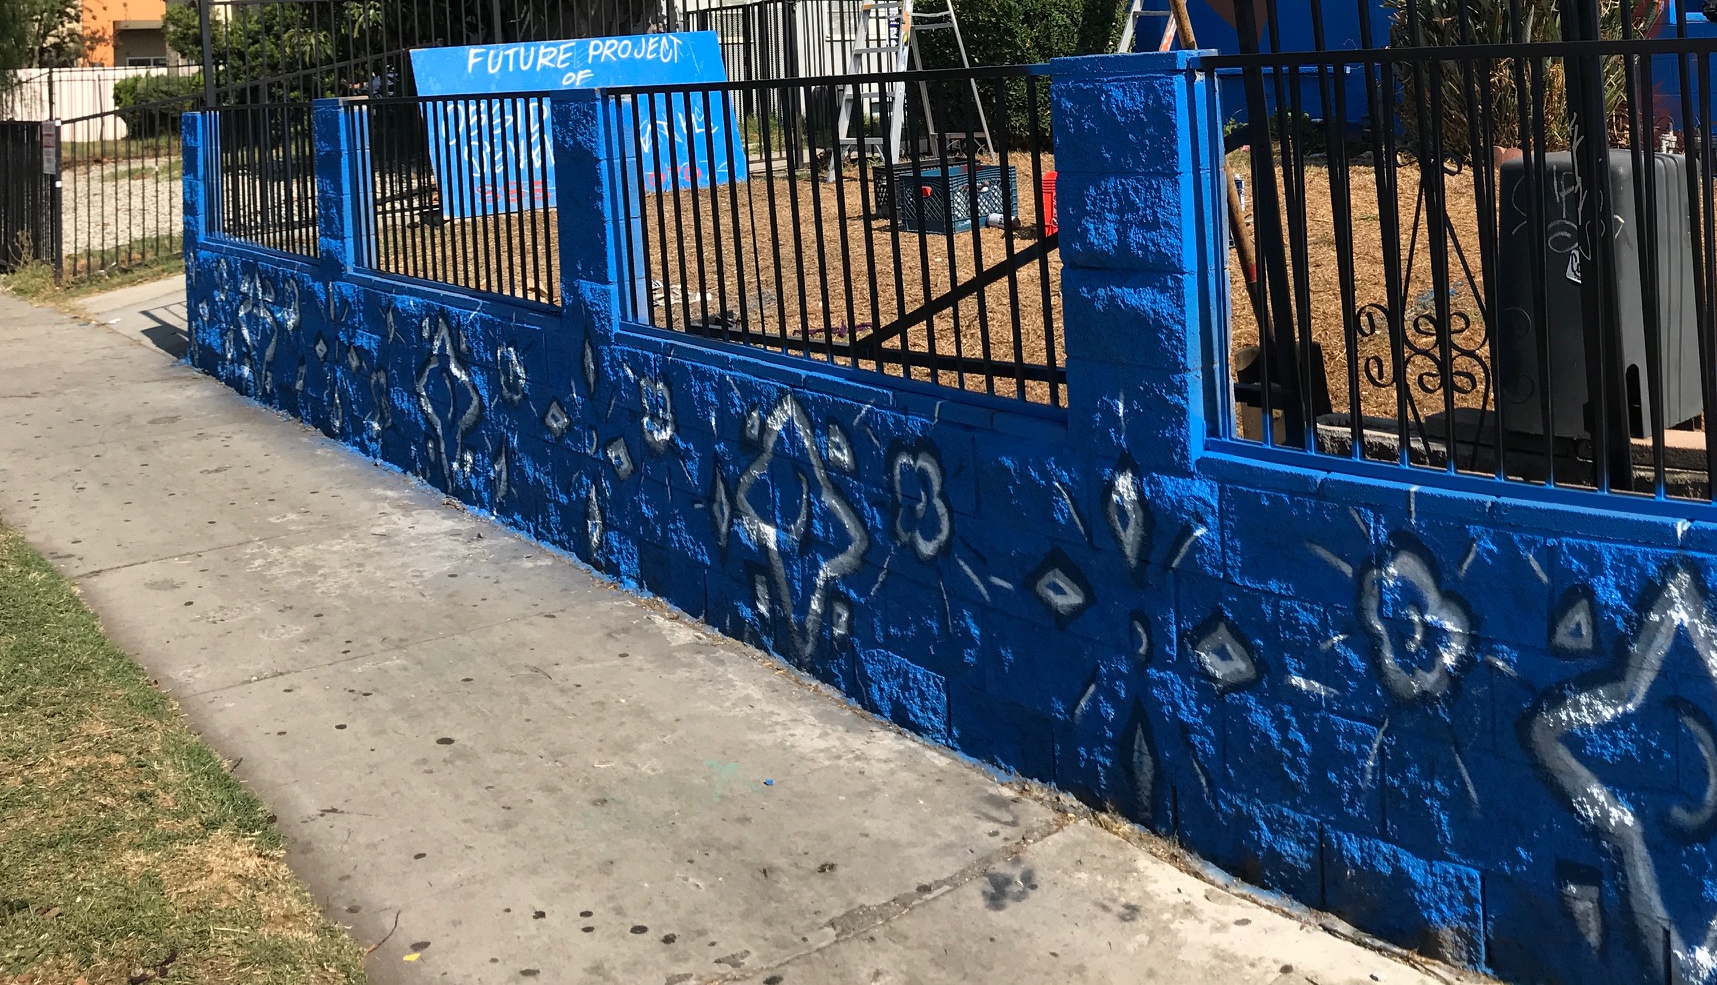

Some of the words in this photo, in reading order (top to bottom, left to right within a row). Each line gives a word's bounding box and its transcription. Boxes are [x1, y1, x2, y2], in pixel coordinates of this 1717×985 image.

[468, 42, 576, 74] FUTURE
[588, 34, 682, 64] PROJECT
[562, 69, 595, 86] OF
